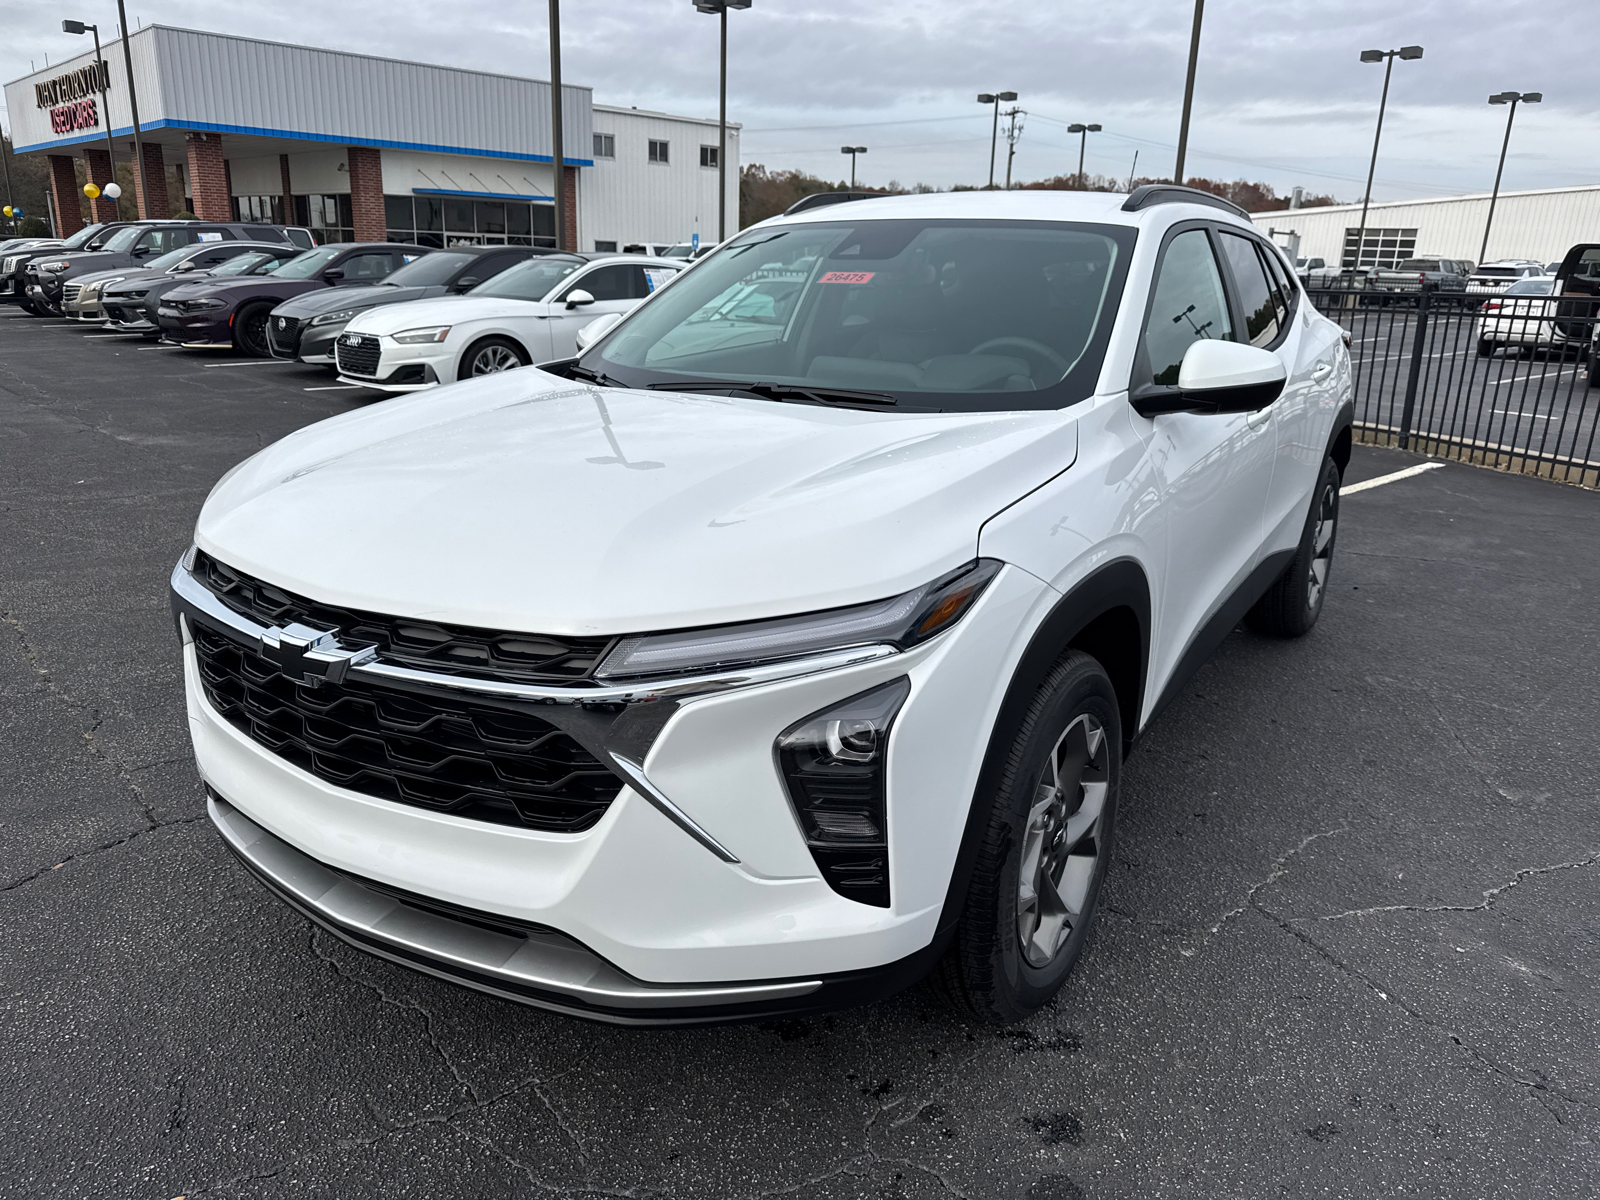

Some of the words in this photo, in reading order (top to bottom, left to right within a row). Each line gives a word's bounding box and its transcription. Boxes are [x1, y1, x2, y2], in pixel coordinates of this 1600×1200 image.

[34, 80, 57, 109] JOHN
[49, 105, 72, 133] USED
[71, 98, 97, 129] CARS
[826, 273, 867, 282] 26475
